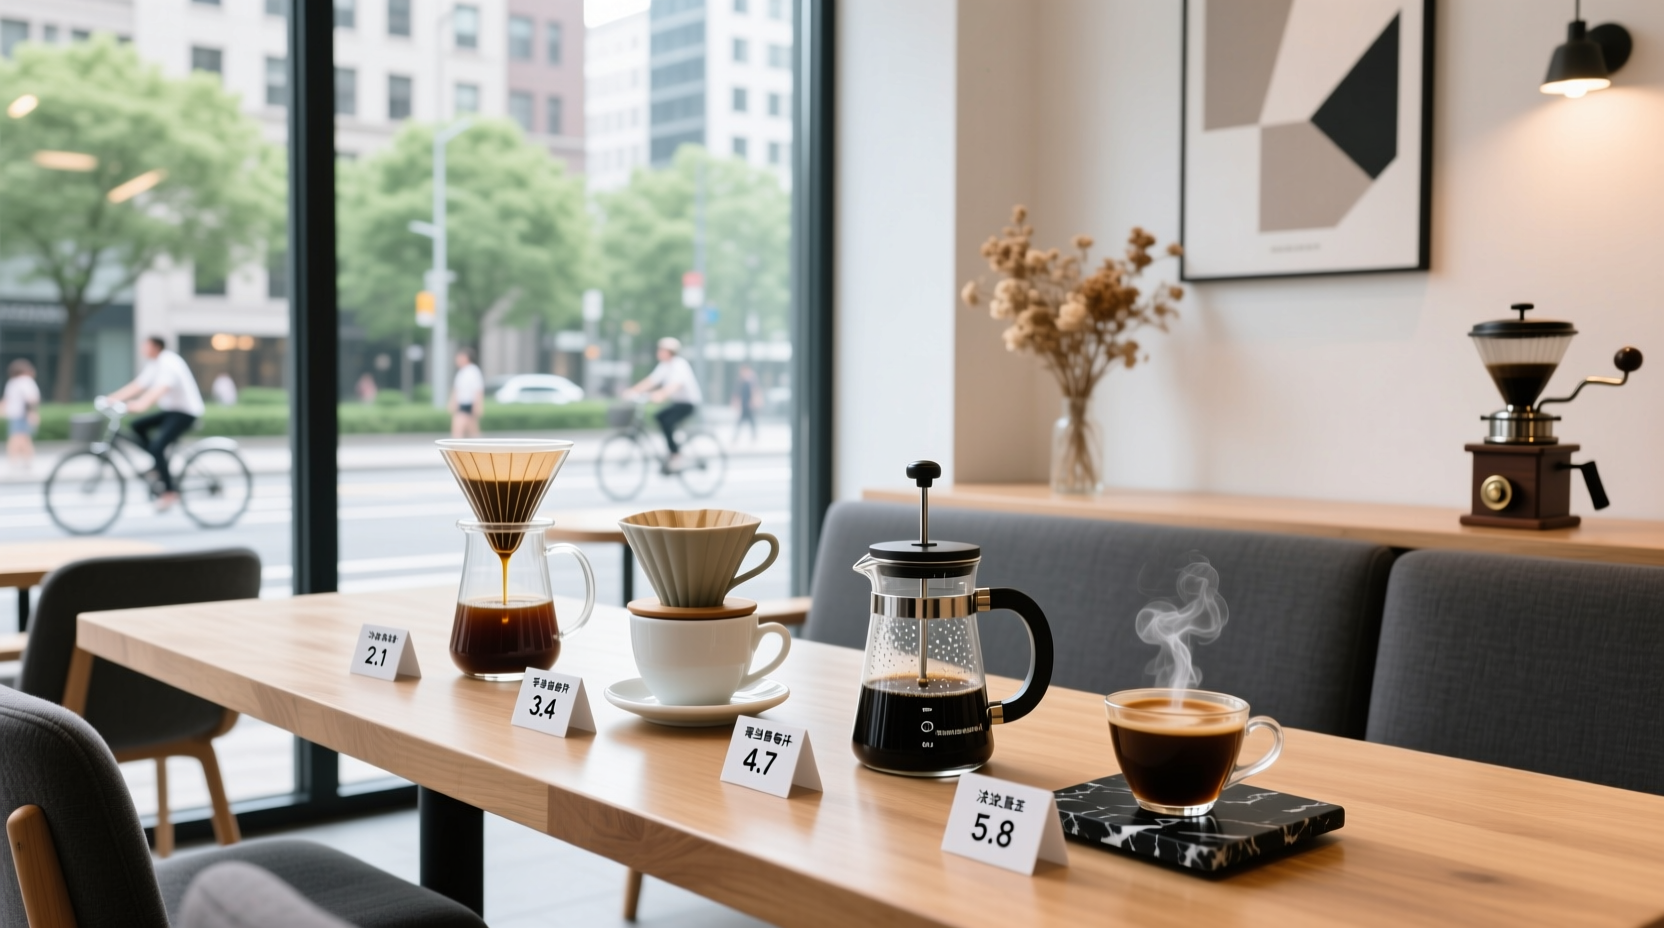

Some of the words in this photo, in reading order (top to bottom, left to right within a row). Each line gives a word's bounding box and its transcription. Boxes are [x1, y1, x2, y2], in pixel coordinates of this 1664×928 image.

[365, 646, 387, 666] 2.1
[529, 695, 556, 719] 3.4
[743, 748, 777, 775] 4.7
[972, 813, 1014, 848] 5.8
